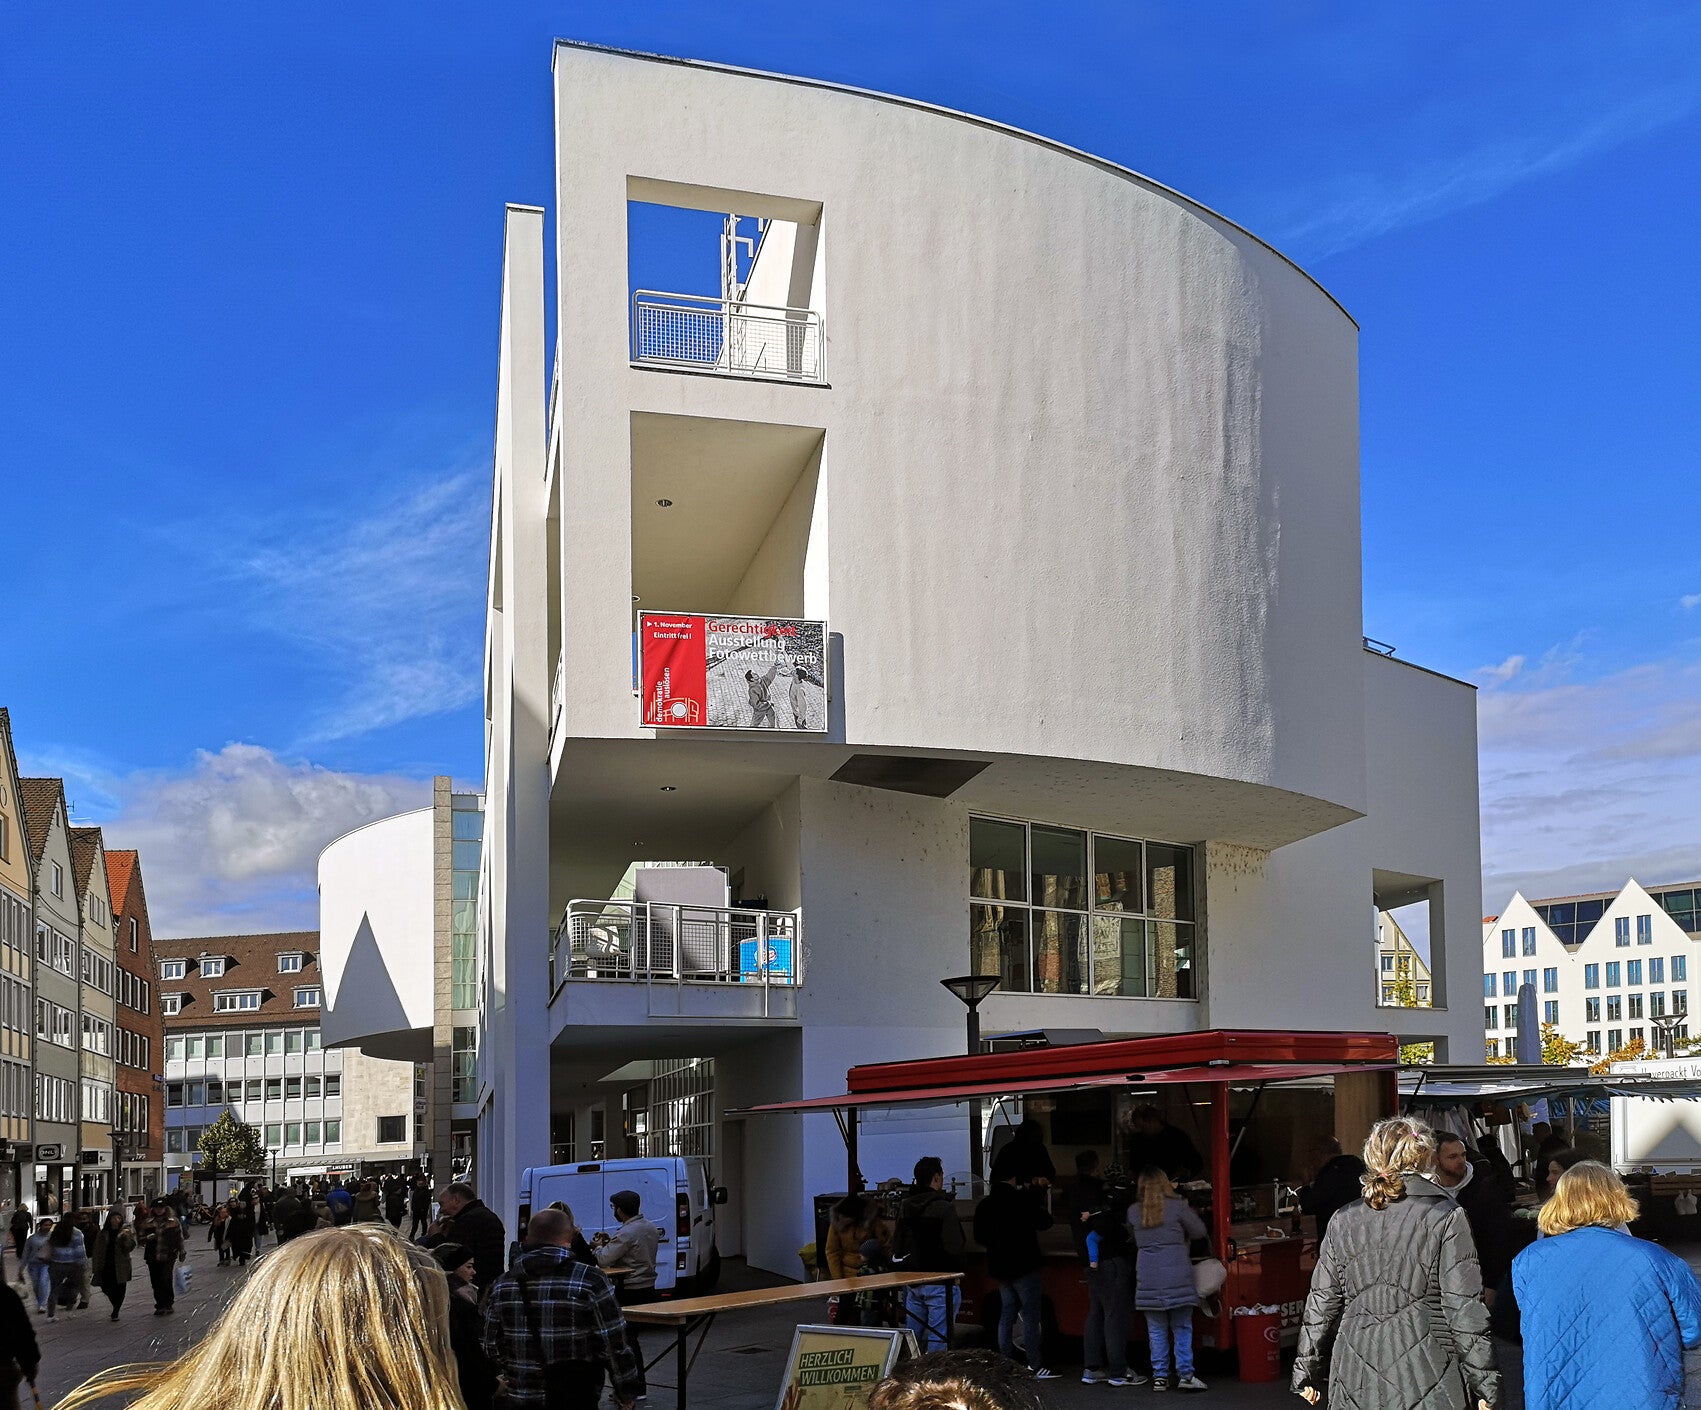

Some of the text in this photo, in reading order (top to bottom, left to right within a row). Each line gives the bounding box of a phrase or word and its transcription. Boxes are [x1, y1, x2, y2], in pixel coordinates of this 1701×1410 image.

[708, 621, 796, 638] Gerechtigkeit
[709, 634, 786, 651] Ausstellung
[709, 647, 817, 664] Fotowettbewerb
[800, 1350, 853, 1367] HERZLICH
[801, 1366, 875, 1385] WILLKOMMEN
